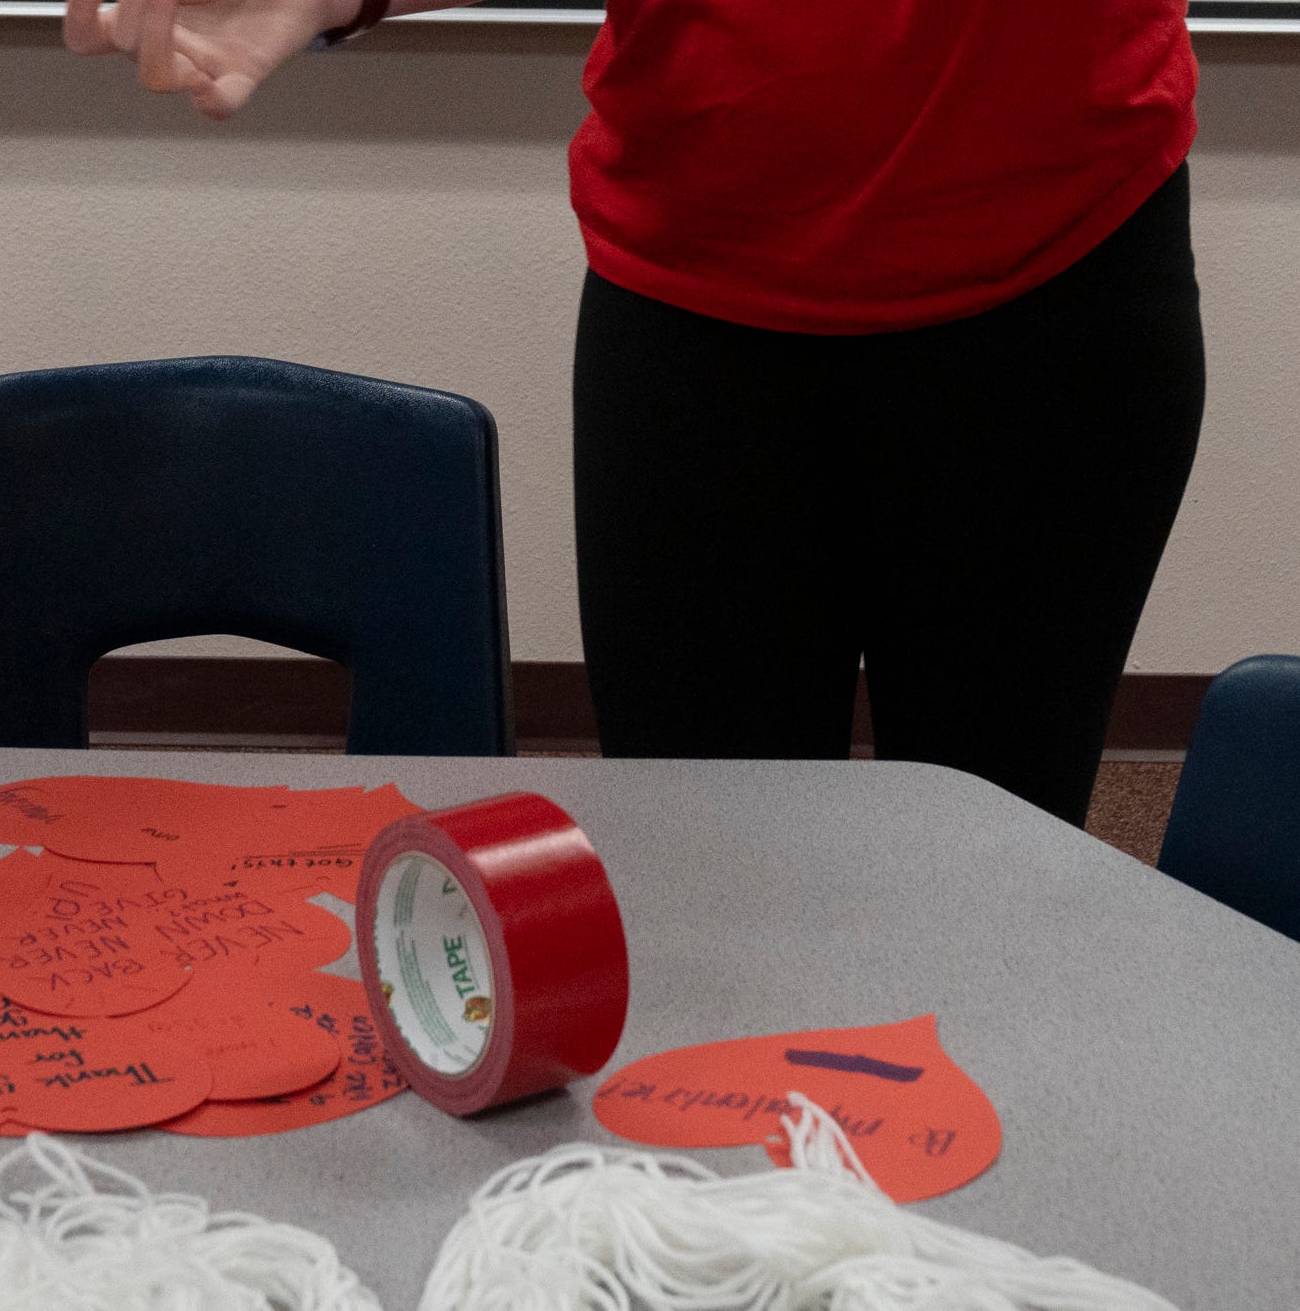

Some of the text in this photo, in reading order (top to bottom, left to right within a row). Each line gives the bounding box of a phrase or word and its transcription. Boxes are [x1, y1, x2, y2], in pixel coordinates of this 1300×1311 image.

[1, 901, 275, 971] DOWN NEVER
[9, 916, 128, 948] NEVER
[159, 920, 305, 966] NEVER
[443, 935, 476, 999] TAPE
